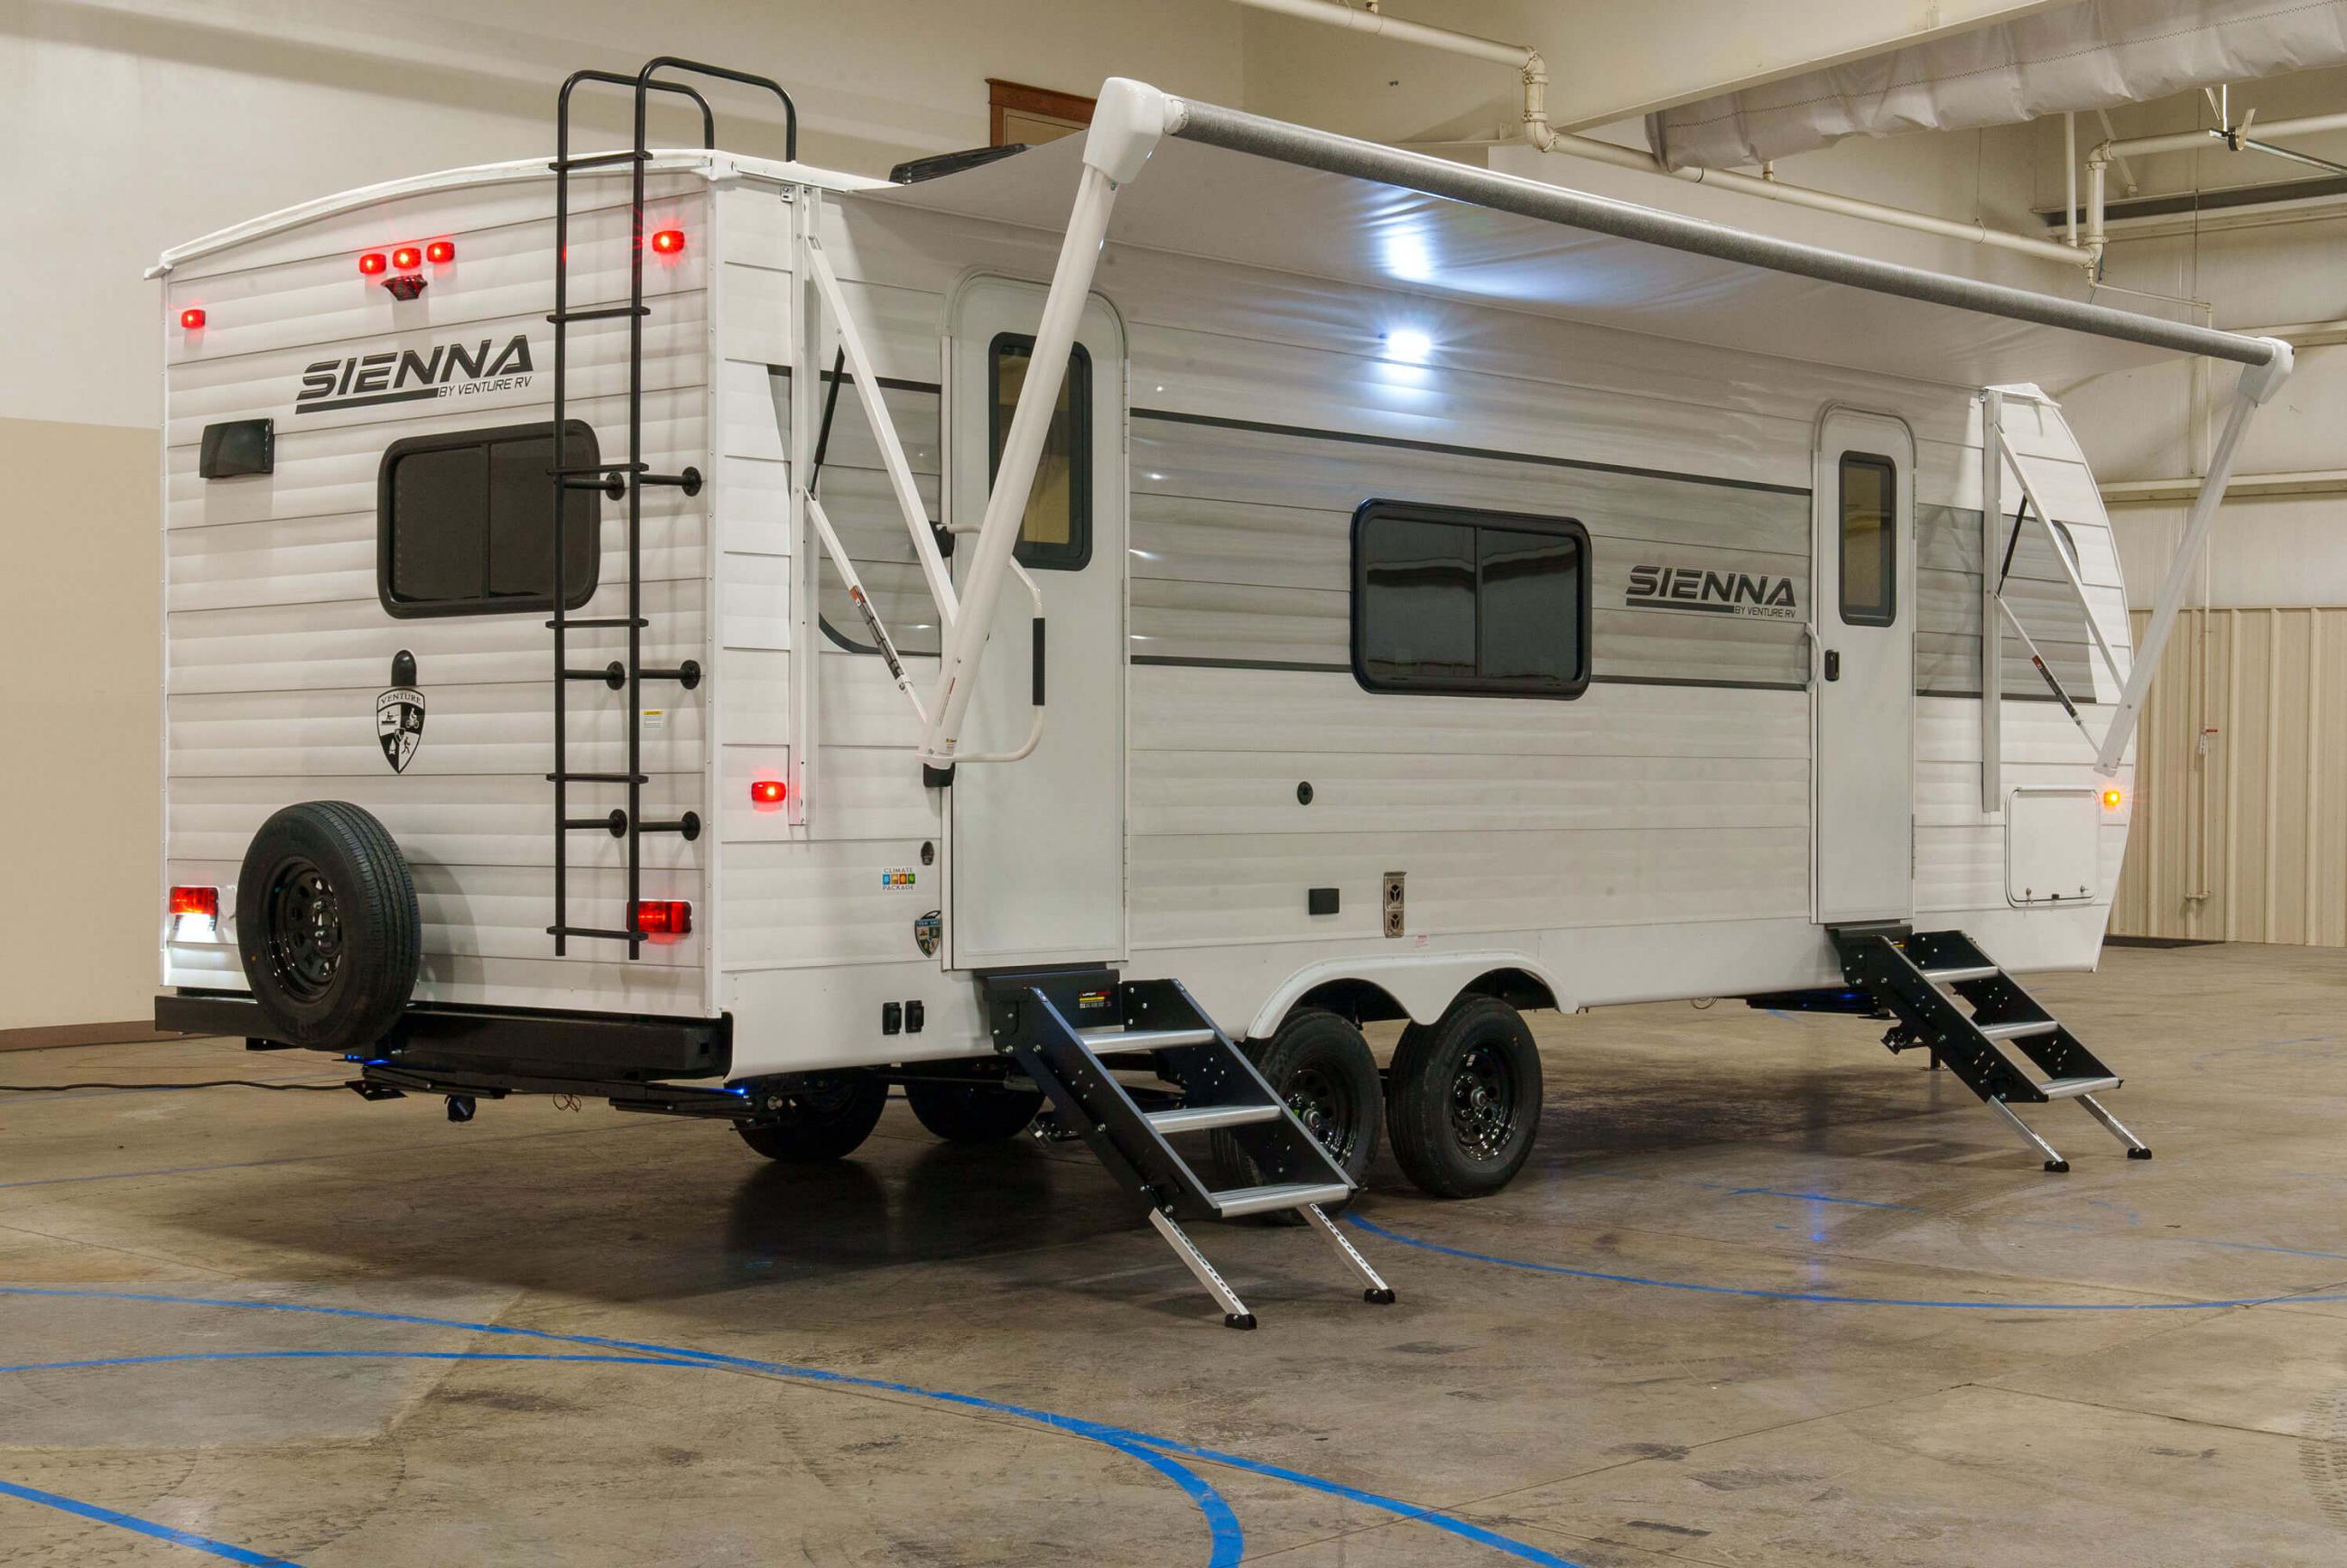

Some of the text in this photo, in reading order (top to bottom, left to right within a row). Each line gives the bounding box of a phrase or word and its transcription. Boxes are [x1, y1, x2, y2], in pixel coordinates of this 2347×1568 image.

[296, 334, 533, 401] SIENNA
[439, 376, 533, 398] BY VENTURE RV
[1626, 565, 1796, 607] SIENNA
[1734, 606, 1796, 618] BY VENTURE RV
[380, 692, 422, 705] VENTURE
